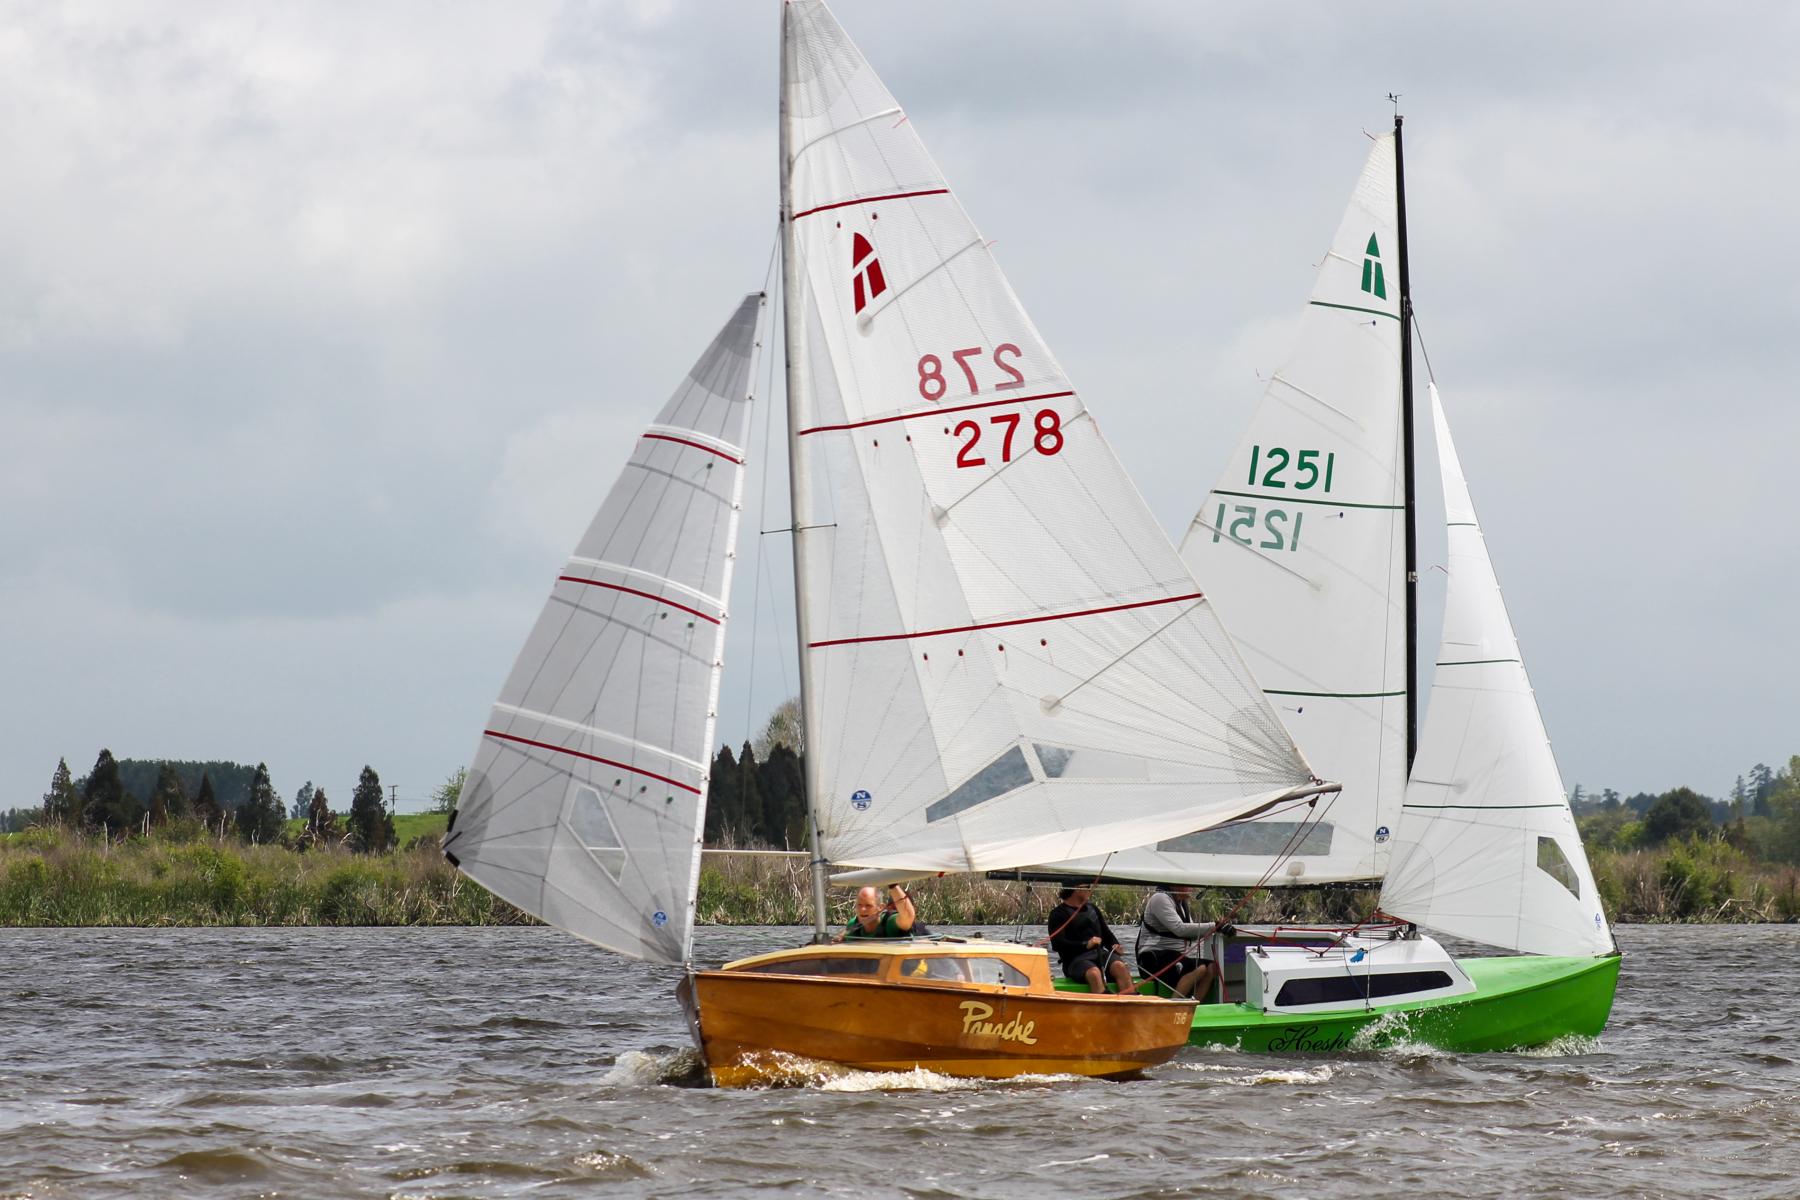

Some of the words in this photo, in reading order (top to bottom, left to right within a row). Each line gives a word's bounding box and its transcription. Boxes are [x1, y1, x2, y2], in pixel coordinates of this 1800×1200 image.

[953, 408, 1064, 468] 278
[1248, 445, 1334, 493] 1251
[959, 1000, 1038, 1045] Panache
